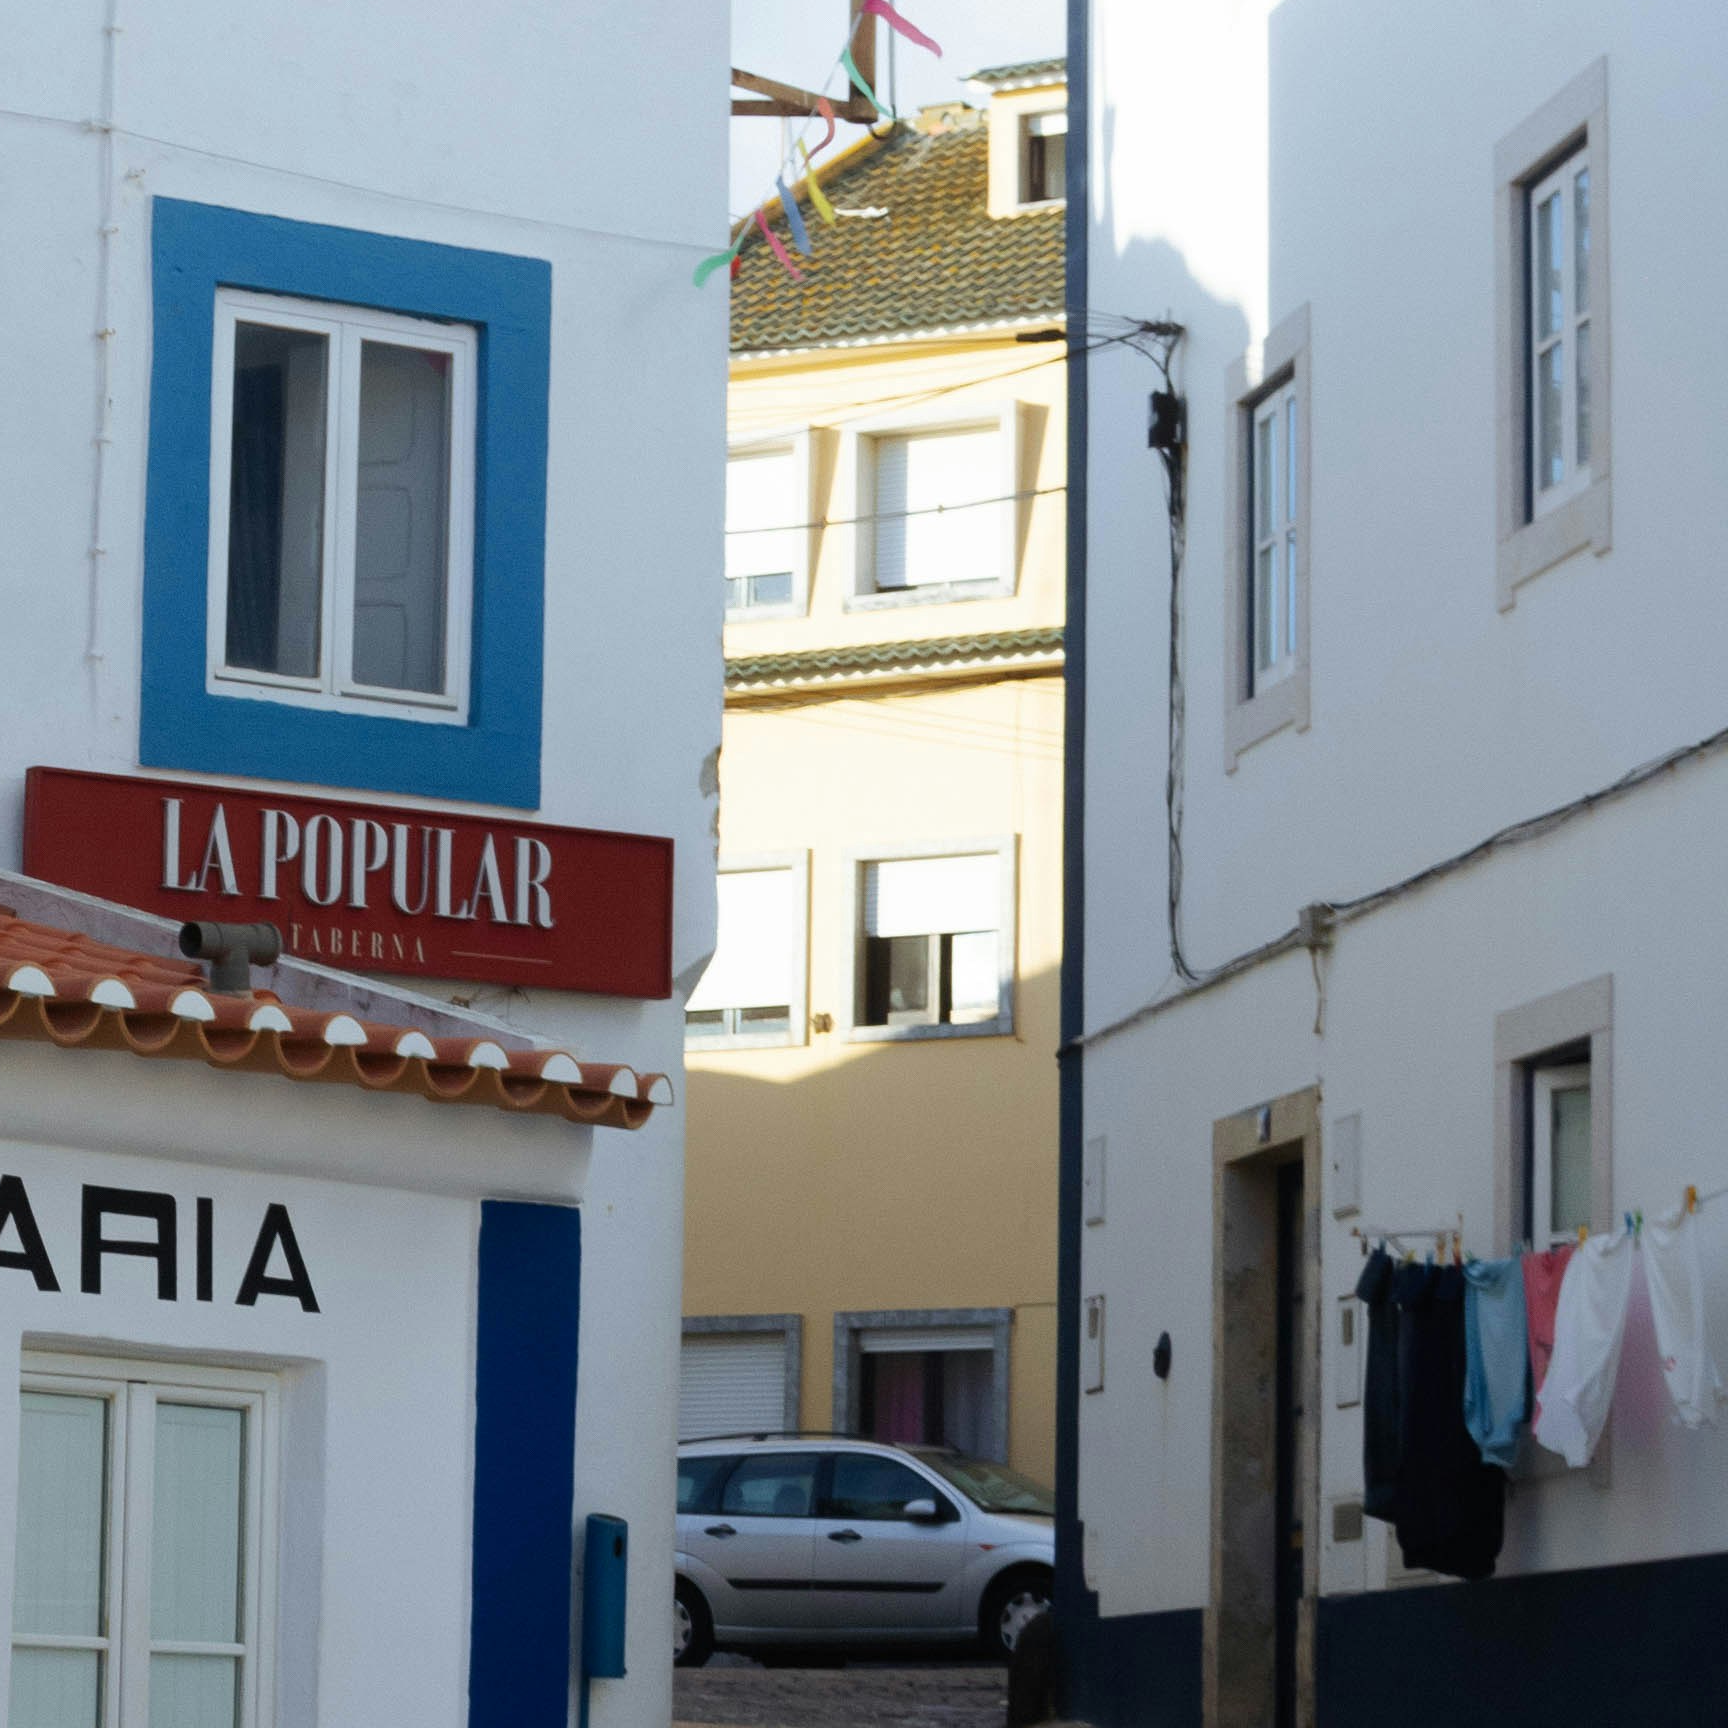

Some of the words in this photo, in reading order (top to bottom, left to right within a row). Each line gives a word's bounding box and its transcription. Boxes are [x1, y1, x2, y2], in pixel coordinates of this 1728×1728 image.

[162, 797, 240, 896] LA
[259, 809, 554, 929] POPULAR
[290, 924, 426, 964] TABERNA
